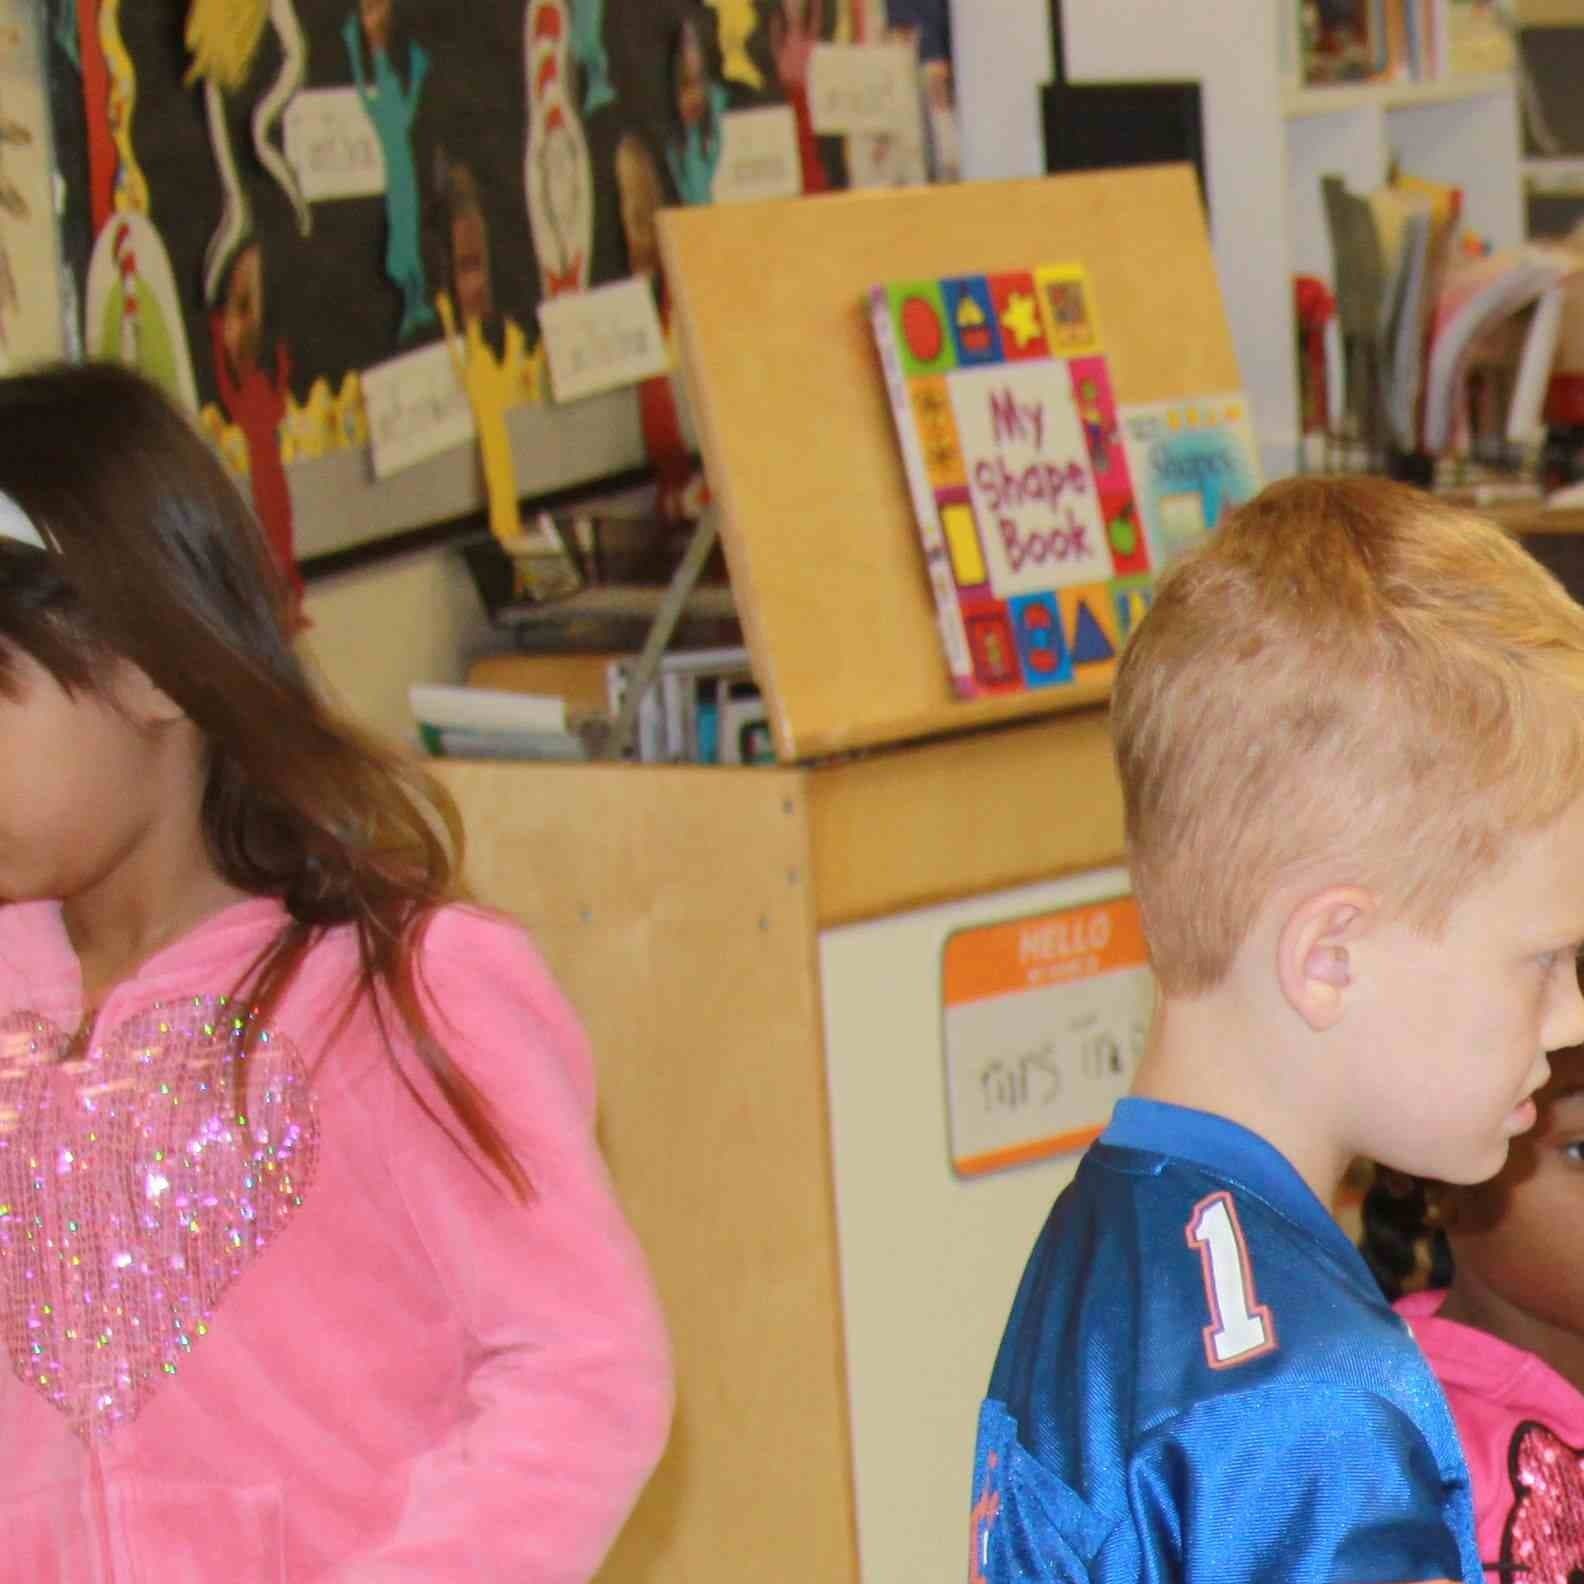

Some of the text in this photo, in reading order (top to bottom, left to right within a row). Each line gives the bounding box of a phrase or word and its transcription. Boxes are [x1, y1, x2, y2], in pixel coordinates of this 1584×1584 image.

[989, 386, 1043, 452] My
[975, 454, 1087, 514] Shape
[998, 506, 1094, 574] Book
[1019, 911, 1111, 965] HELLO
[1186, 1190, 1279, 1370] 1
